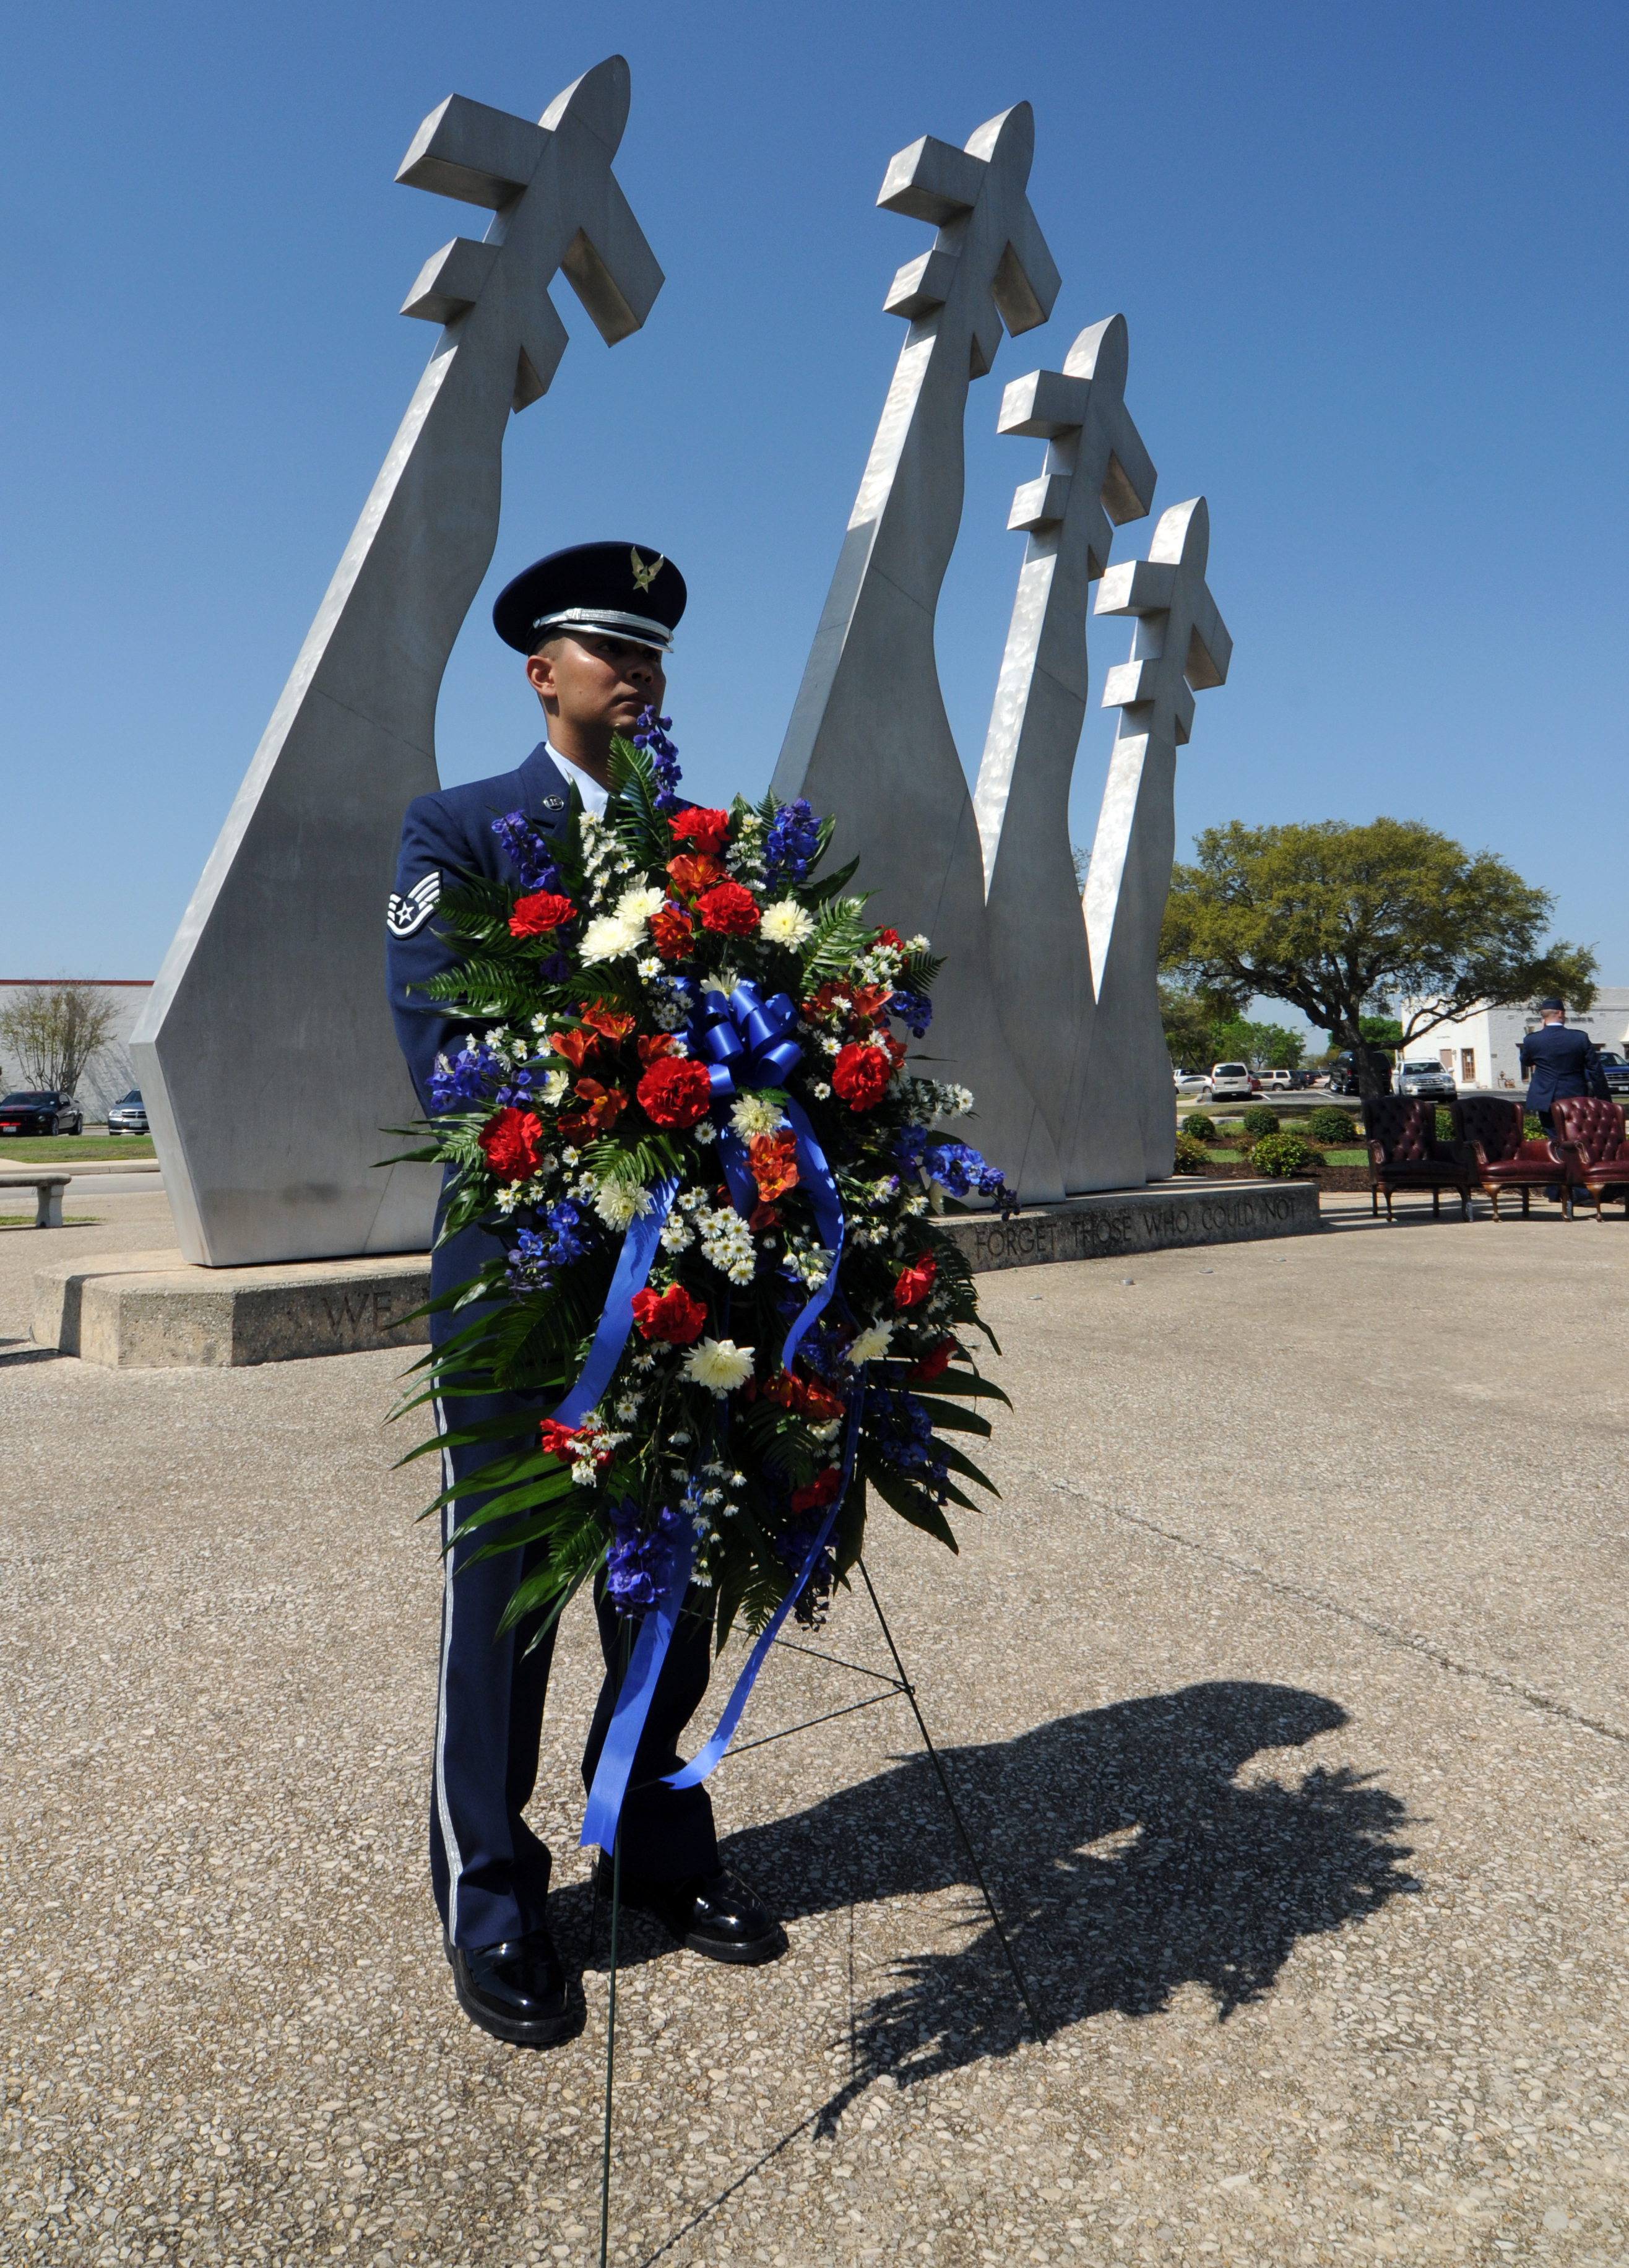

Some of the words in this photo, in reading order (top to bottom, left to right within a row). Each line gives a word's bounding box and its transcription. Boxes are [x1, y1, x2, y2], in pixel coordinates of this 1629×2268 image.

[974, 1224, 1056, 1259] FORGET
[1070, 1215, 1132, 1248] THOSE
[1143, 1210, 1189, 1237] WHO
[1201, 1203, 1253, 1231] COULD
[1263, 1197, 1295, 1223] NOT
[321, 1291, 392, 1336] WE
